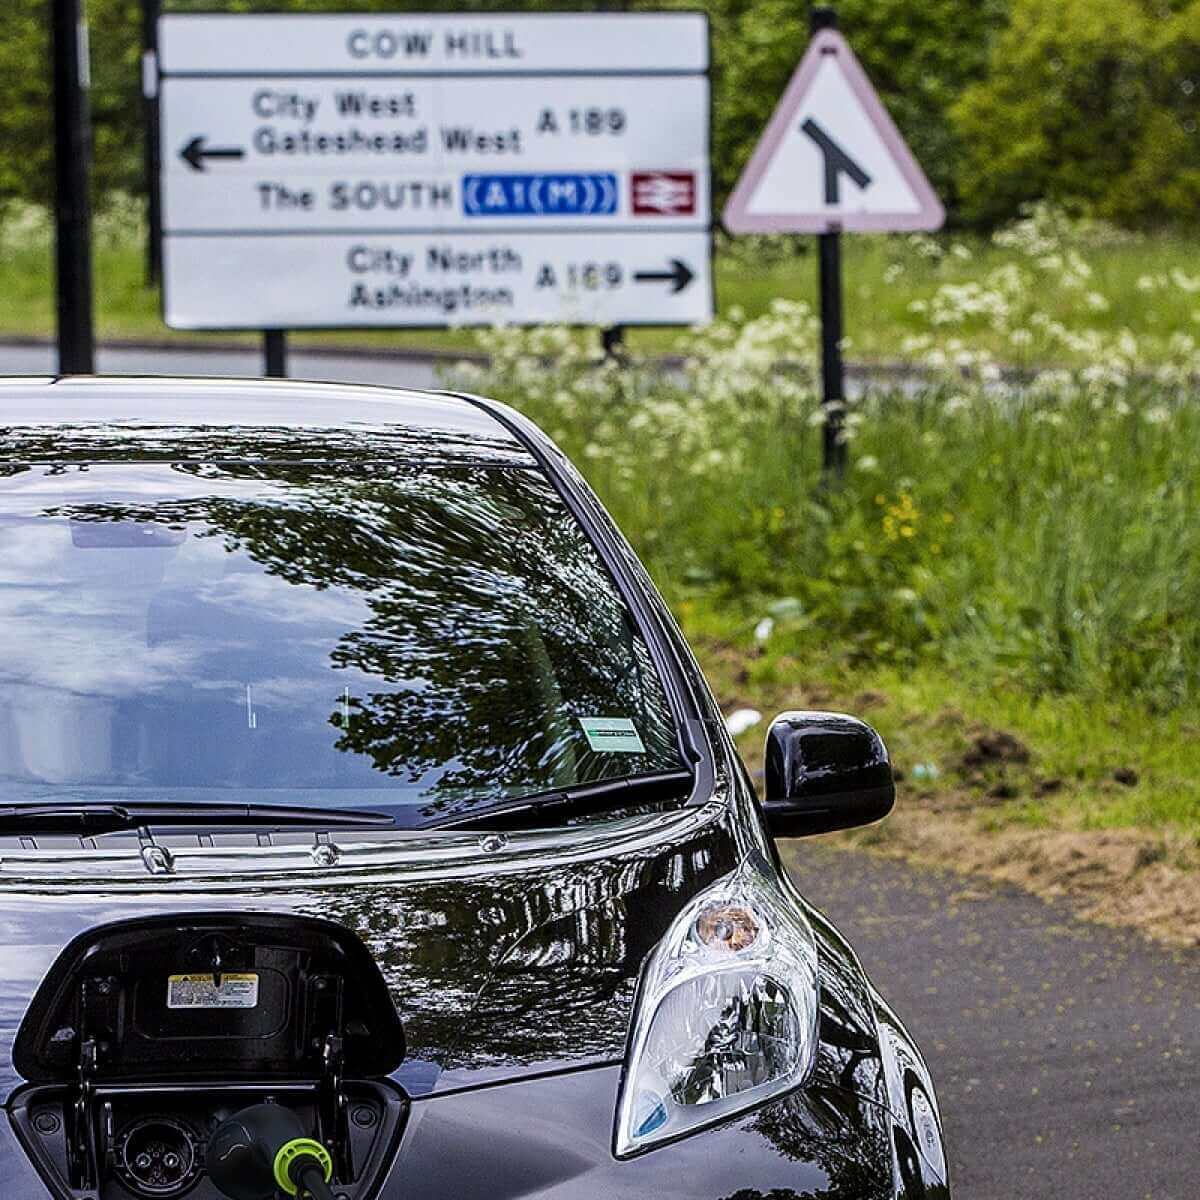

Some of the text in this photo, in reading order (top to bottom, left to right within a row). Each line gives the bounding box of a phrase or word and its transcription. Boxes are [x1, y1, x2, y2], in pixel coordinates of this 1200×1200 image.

[347, 30, 522, 59] COW HILL
[252, 90, 415, 124] City West
[252, 127, 521, 156] Gateshead West
[255, 181, 315, 211] The
[329, 181, 453, 211] SOUTH
[346, 245, 522, 279] City North
[347, 282, 514, 314] Ashington
